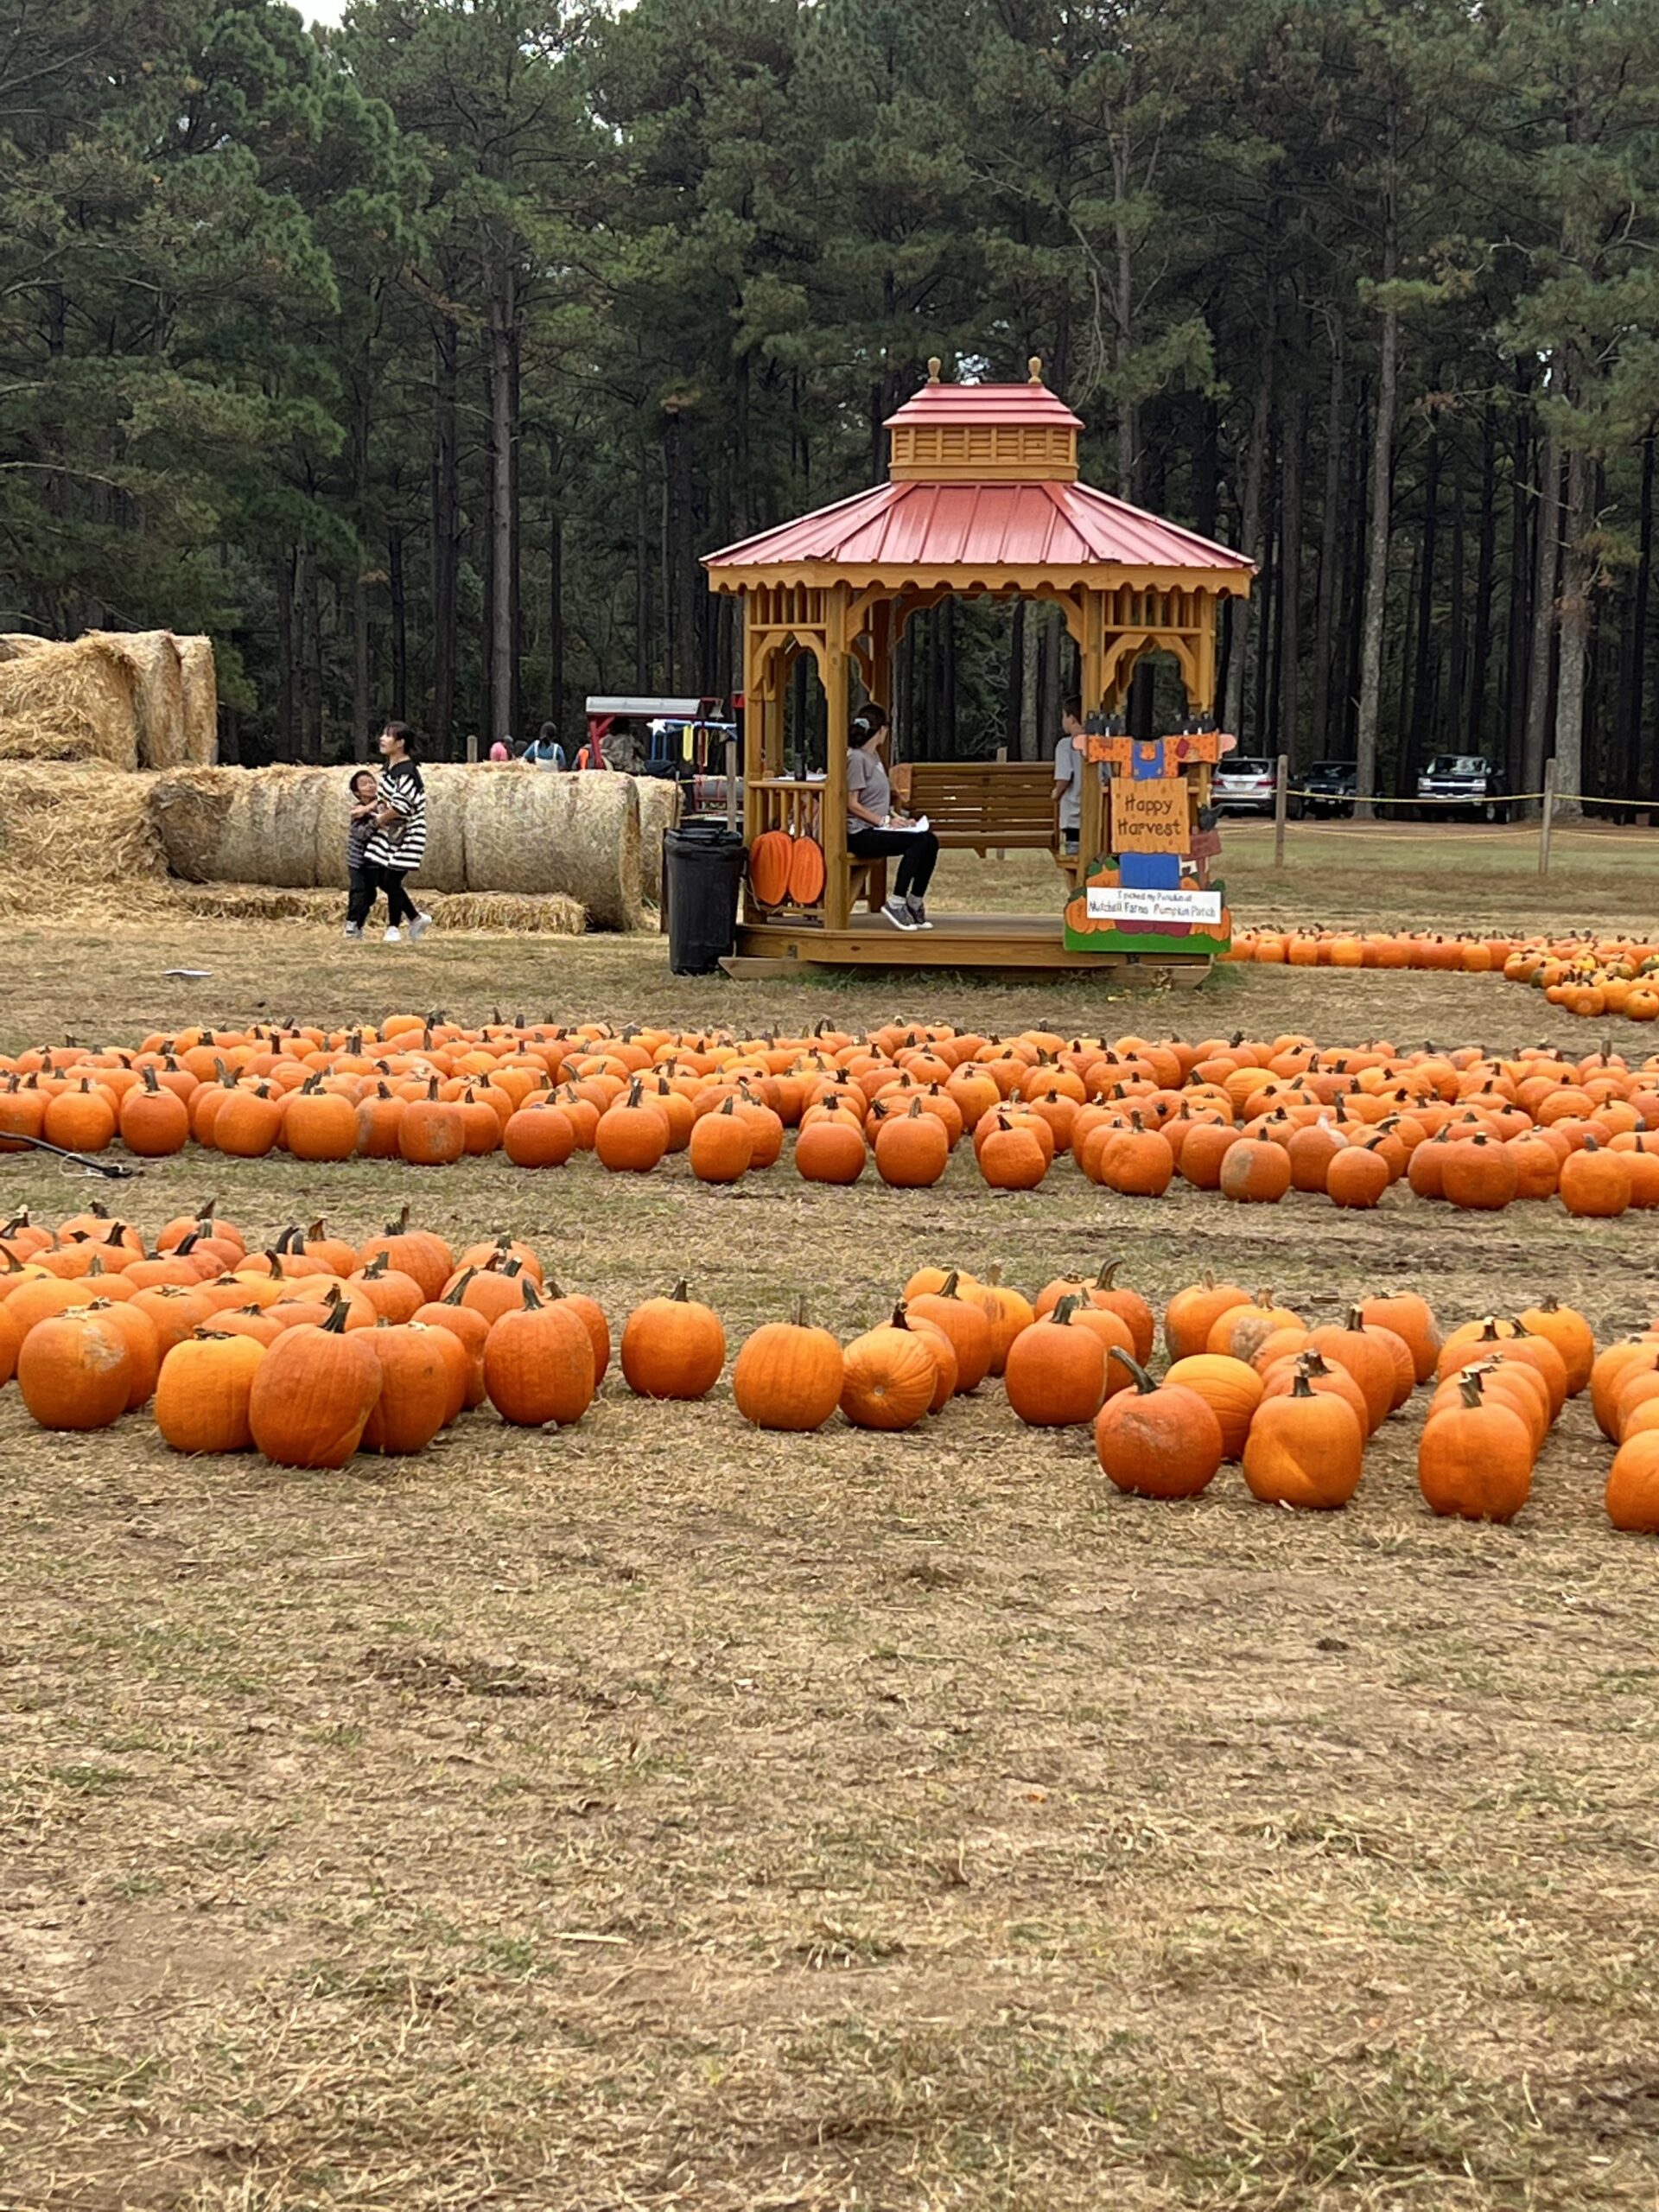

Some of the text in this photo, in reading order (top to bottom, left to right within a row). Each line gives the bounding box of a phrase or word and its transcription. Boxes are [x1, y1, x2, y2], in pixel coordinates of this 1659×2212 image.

[1125, 793, 1173, 816] Happy
[1118, 818, 1180, 836] Harvest
[1147, 893, 1156, 902] my
[1124, 902, 1148, 914] Farms
[1154, 903, 1190, 917] Pumpkin
[1191, 905, 1216, 918] Patch
